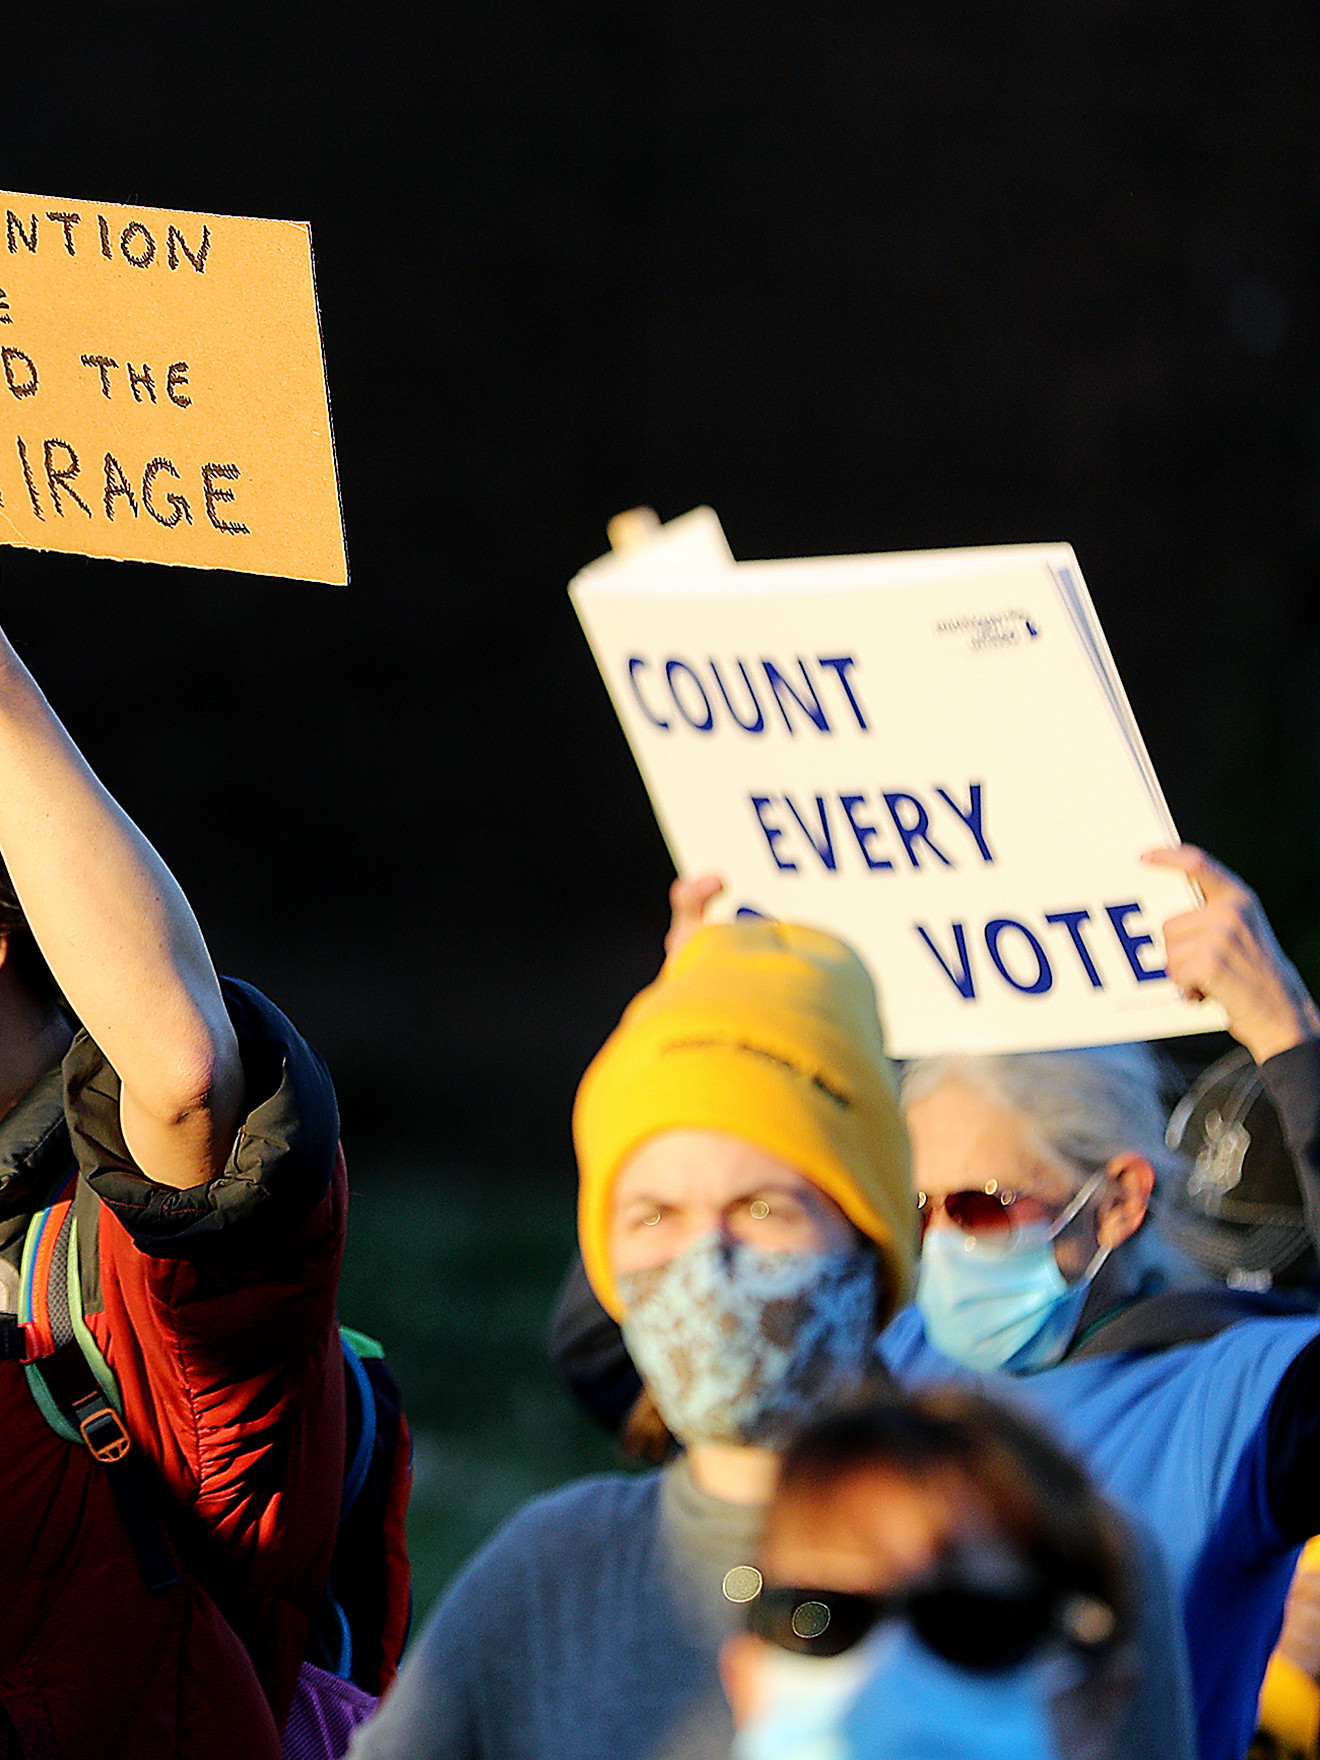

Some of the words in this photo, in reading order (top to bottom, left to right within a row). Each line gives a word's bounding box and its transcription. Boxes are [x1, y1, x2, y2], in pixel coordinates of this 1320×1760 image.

[81, 355, 192, 408] THE
[629, 657, 868, 734] COUNT
[751, 784, 993, 872] EVERY
[916, 902, 1167, 1000] VOTE
